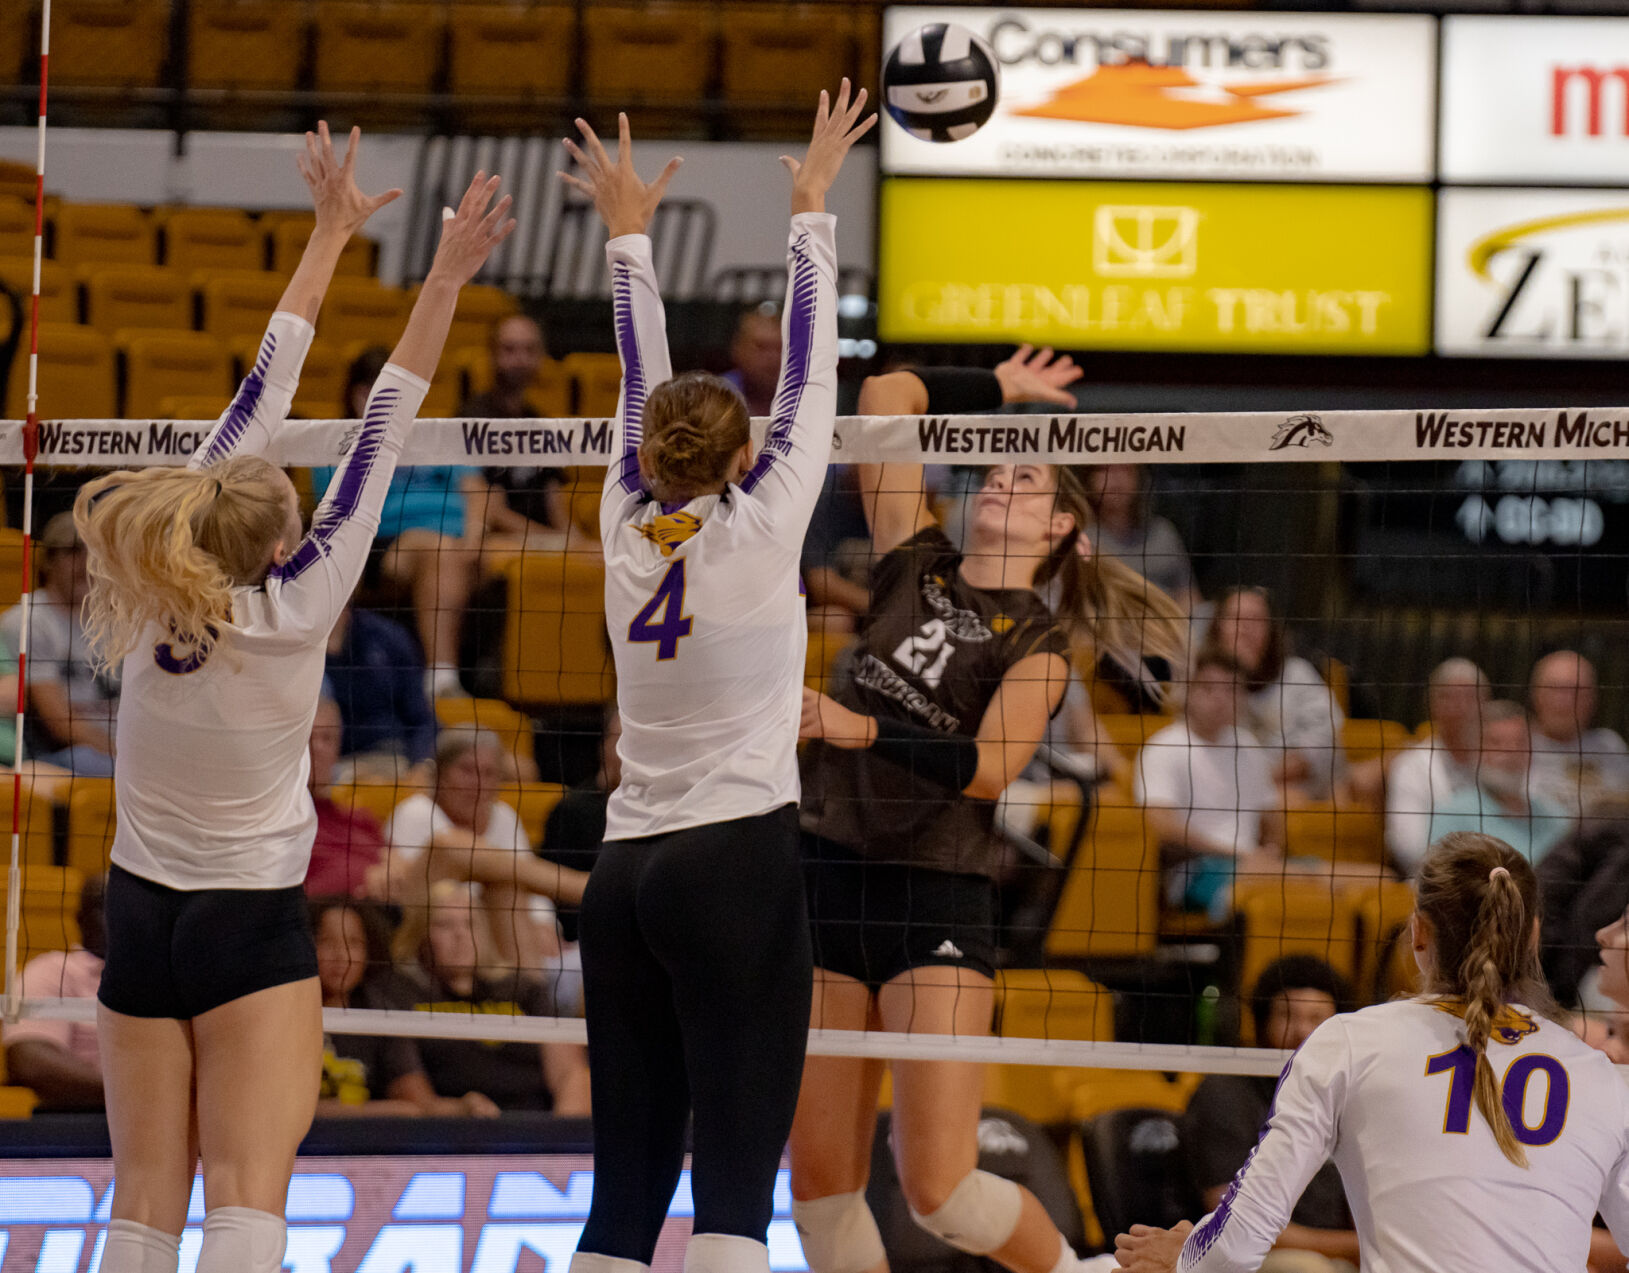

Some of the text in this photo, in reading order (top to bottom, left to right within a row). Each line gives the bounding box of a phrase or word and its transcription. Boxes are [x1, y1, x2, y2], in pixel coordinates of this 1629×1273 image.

[989, 14, 1331, 70] Consumers
[903, 281, 1391, 334] GREENLEAF TRUST
[37, 423, 142, 454] WESTERN
[462, 422, 574, 455] WESTERN
[918, 417, 1185, 453] WESTERN MICHIGAN
[1416, 412, 1546, 448] WESTERN
[628, 557, 694, 662] 4
[1424, 1043, 1571, 1147] 10
